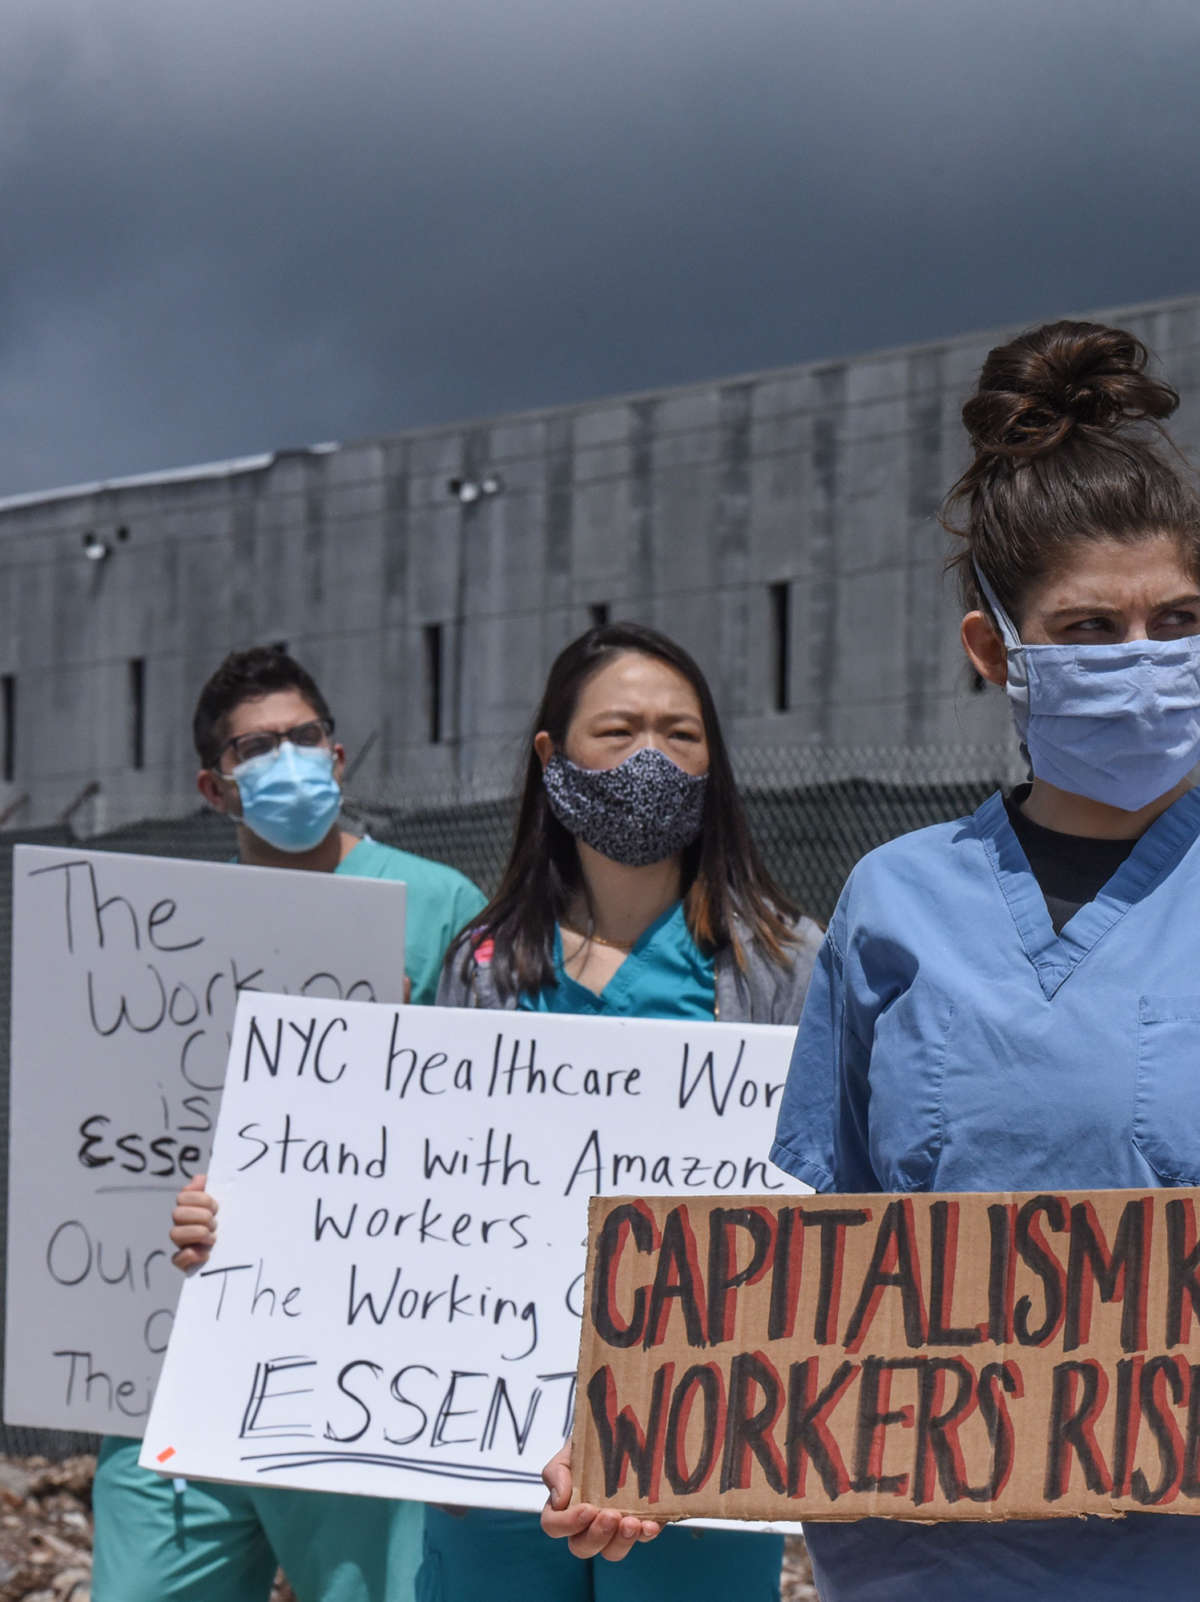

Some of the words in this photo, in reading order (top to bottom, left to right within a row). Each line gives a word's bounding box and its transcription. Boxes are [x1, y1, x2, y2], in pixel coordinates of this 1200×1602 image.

[28, 860, 205, 955] The
[87, 957, 378, 1037] Work
[242, 1014, 349, 1085] NYC
[384, 1011, 643, 1098] healthcare
[157, 1081, 213, 1132] is
[236, 1113, 388, 1179] Stand
[423, 1126, 542, 1187] with
[562, 1128, 786, 1196] Amazon
[46, 1219, 167, 1293] Our
[591, 1197, 1155, 1354] CAPITALISM
[199, 1257, 303, 1321] The
[346, 1263, 539, 1362] Working
[586, 1349, 1025, 1507] WORKERS
